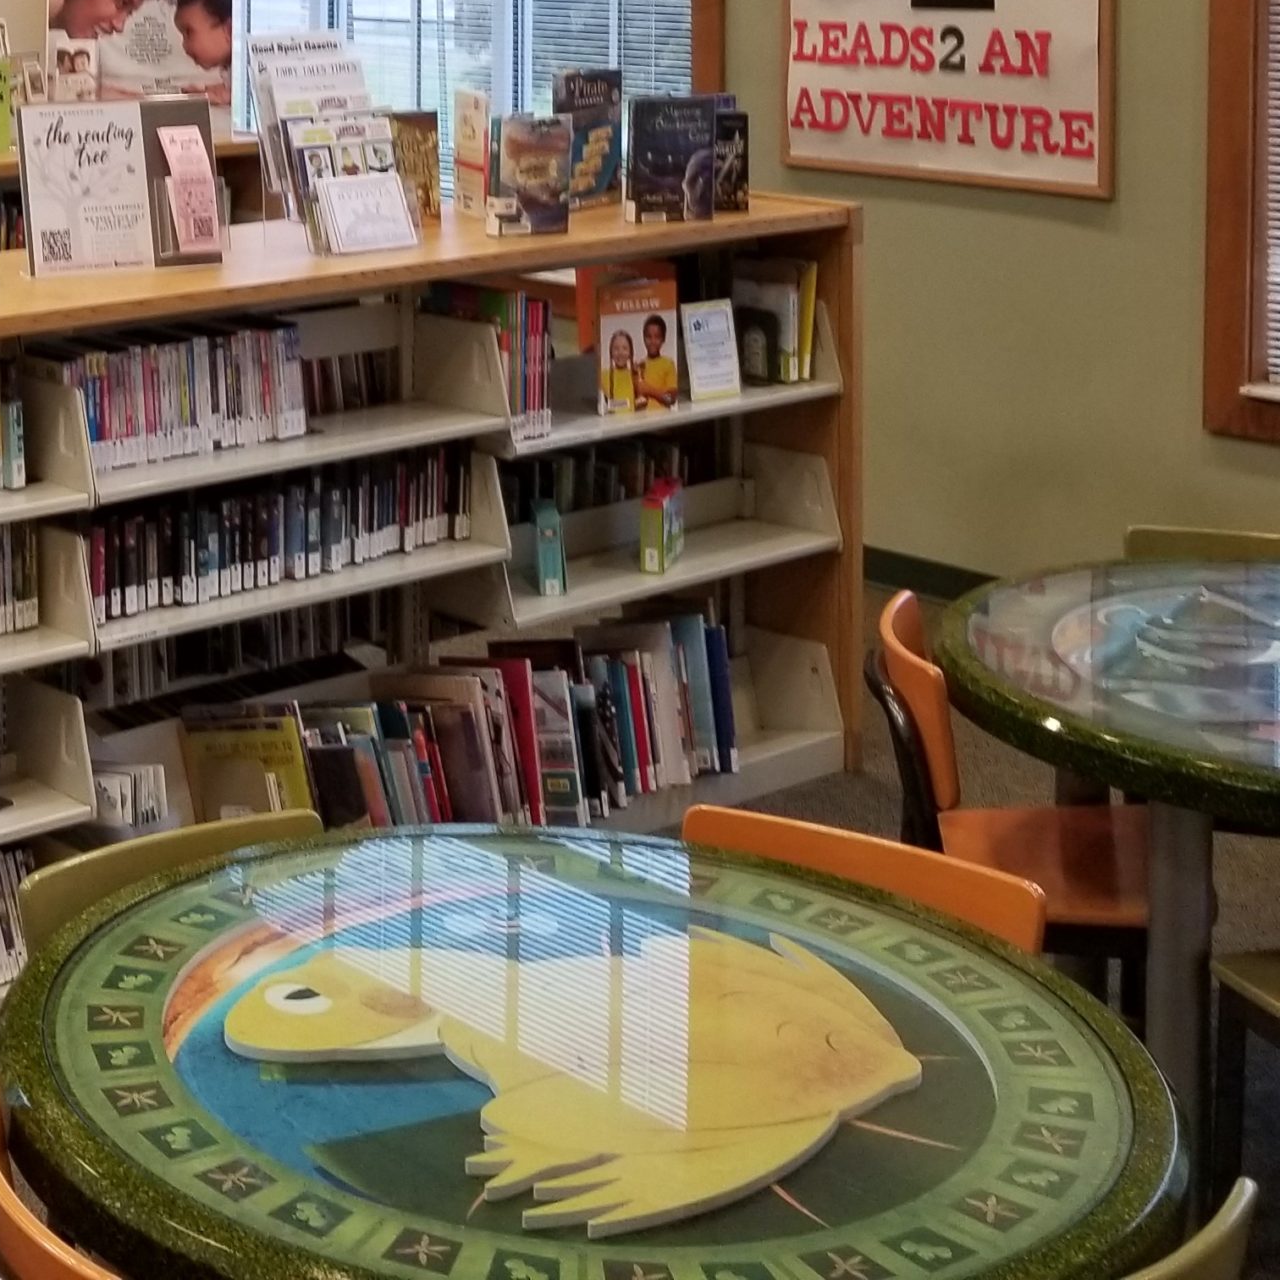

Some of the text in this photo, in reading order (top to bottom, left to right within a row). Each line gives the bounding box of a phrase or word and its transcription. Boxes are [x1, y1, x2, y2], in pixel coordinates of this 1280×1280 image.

[791, 19, 936, 72] LEADS
[978, 30, 1052, 77] AN
[45, 115, 133, 152] the reading
[789, 87, 1095, 159] ADVENTURE
[78, 142, 108, 168] tree
[615, 298, 660, 312] YELLOW
